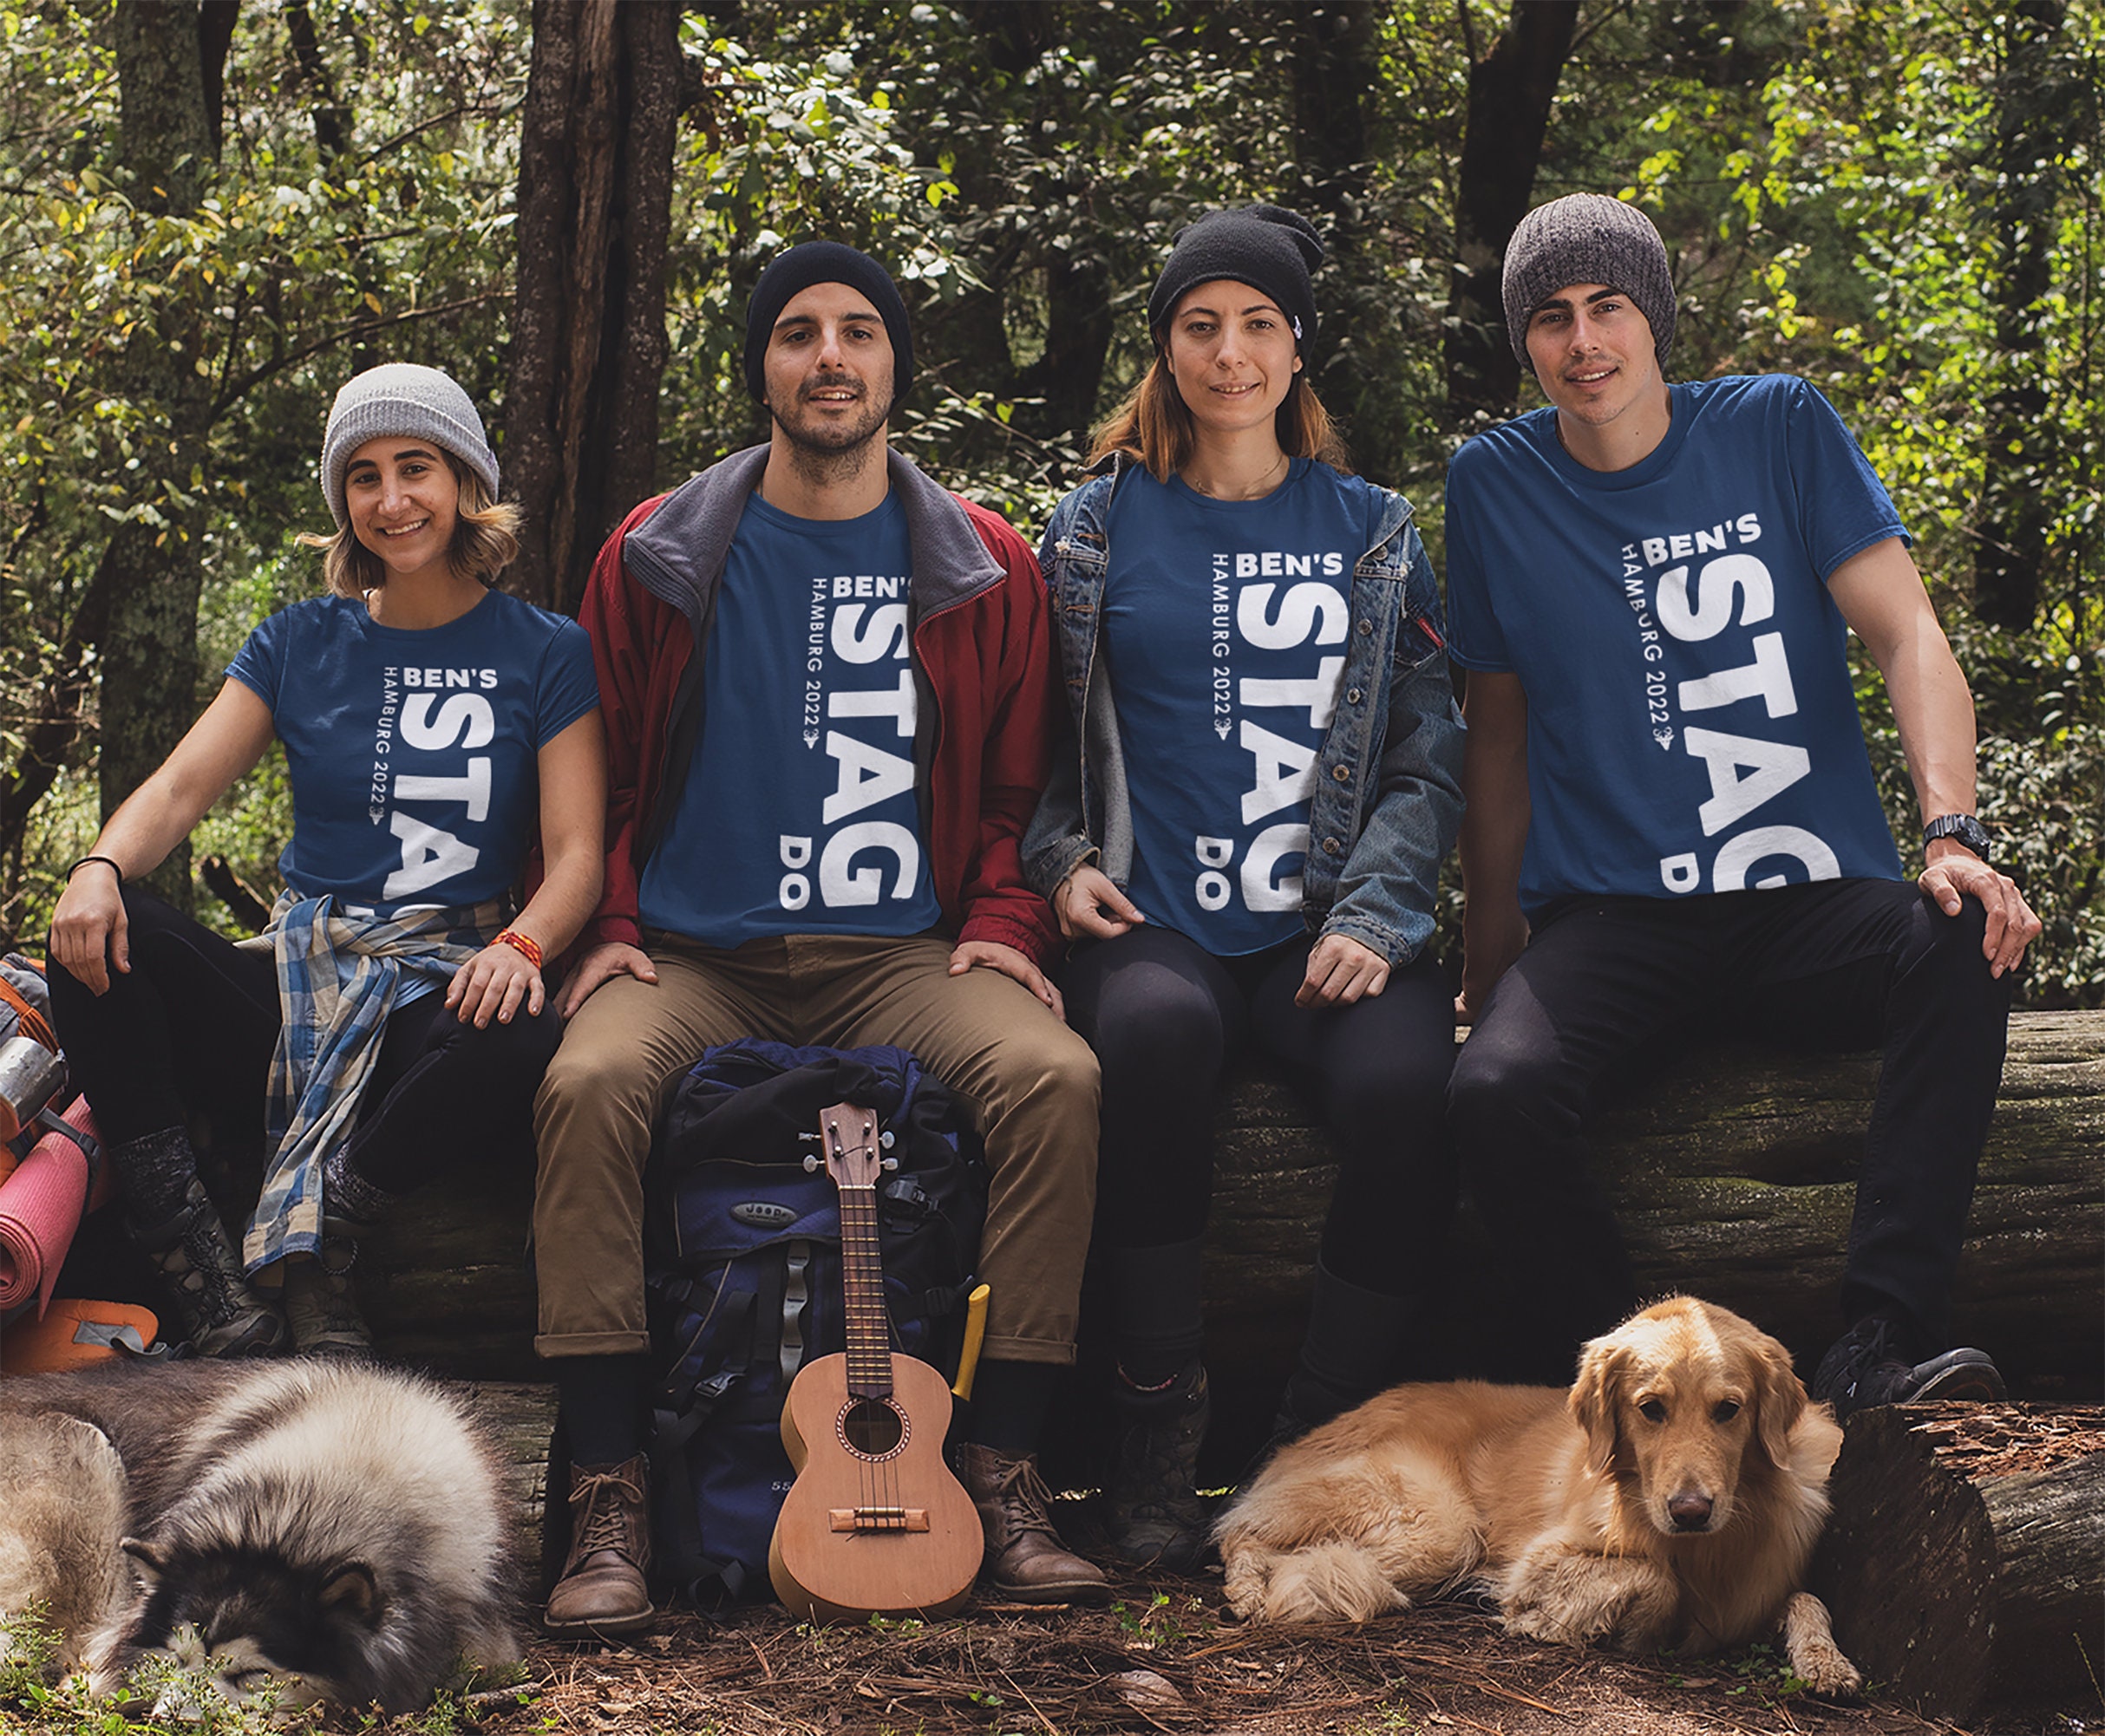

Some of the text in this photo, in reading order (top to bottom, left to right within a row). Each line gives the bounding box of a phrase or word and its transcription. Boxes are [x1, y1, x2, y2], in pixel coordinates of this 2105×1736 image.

[1236, 551, 1343, 578] BEN'S
[1642, 512, 1762, 567] BEN'S
[833, 575, 912, 598] BEN'
[804, 578, 827, 726] HAMBURG 2022
[1212, 553, 1232, 715] HAMBURG 2022
[1621, 543, 1670, 724] HAMBURG 2022
[403, 667, 498, 689] BEN'S
[370, 667, 399, 804] HAMBURG 2022
[818, 603, 919, 908] STAG
[382, 693, 495, 919] STA
[779, 834, 813, 910] DO
[1195, 835, 1234, 911] DO
[1659, 852, 1700, 894] D
